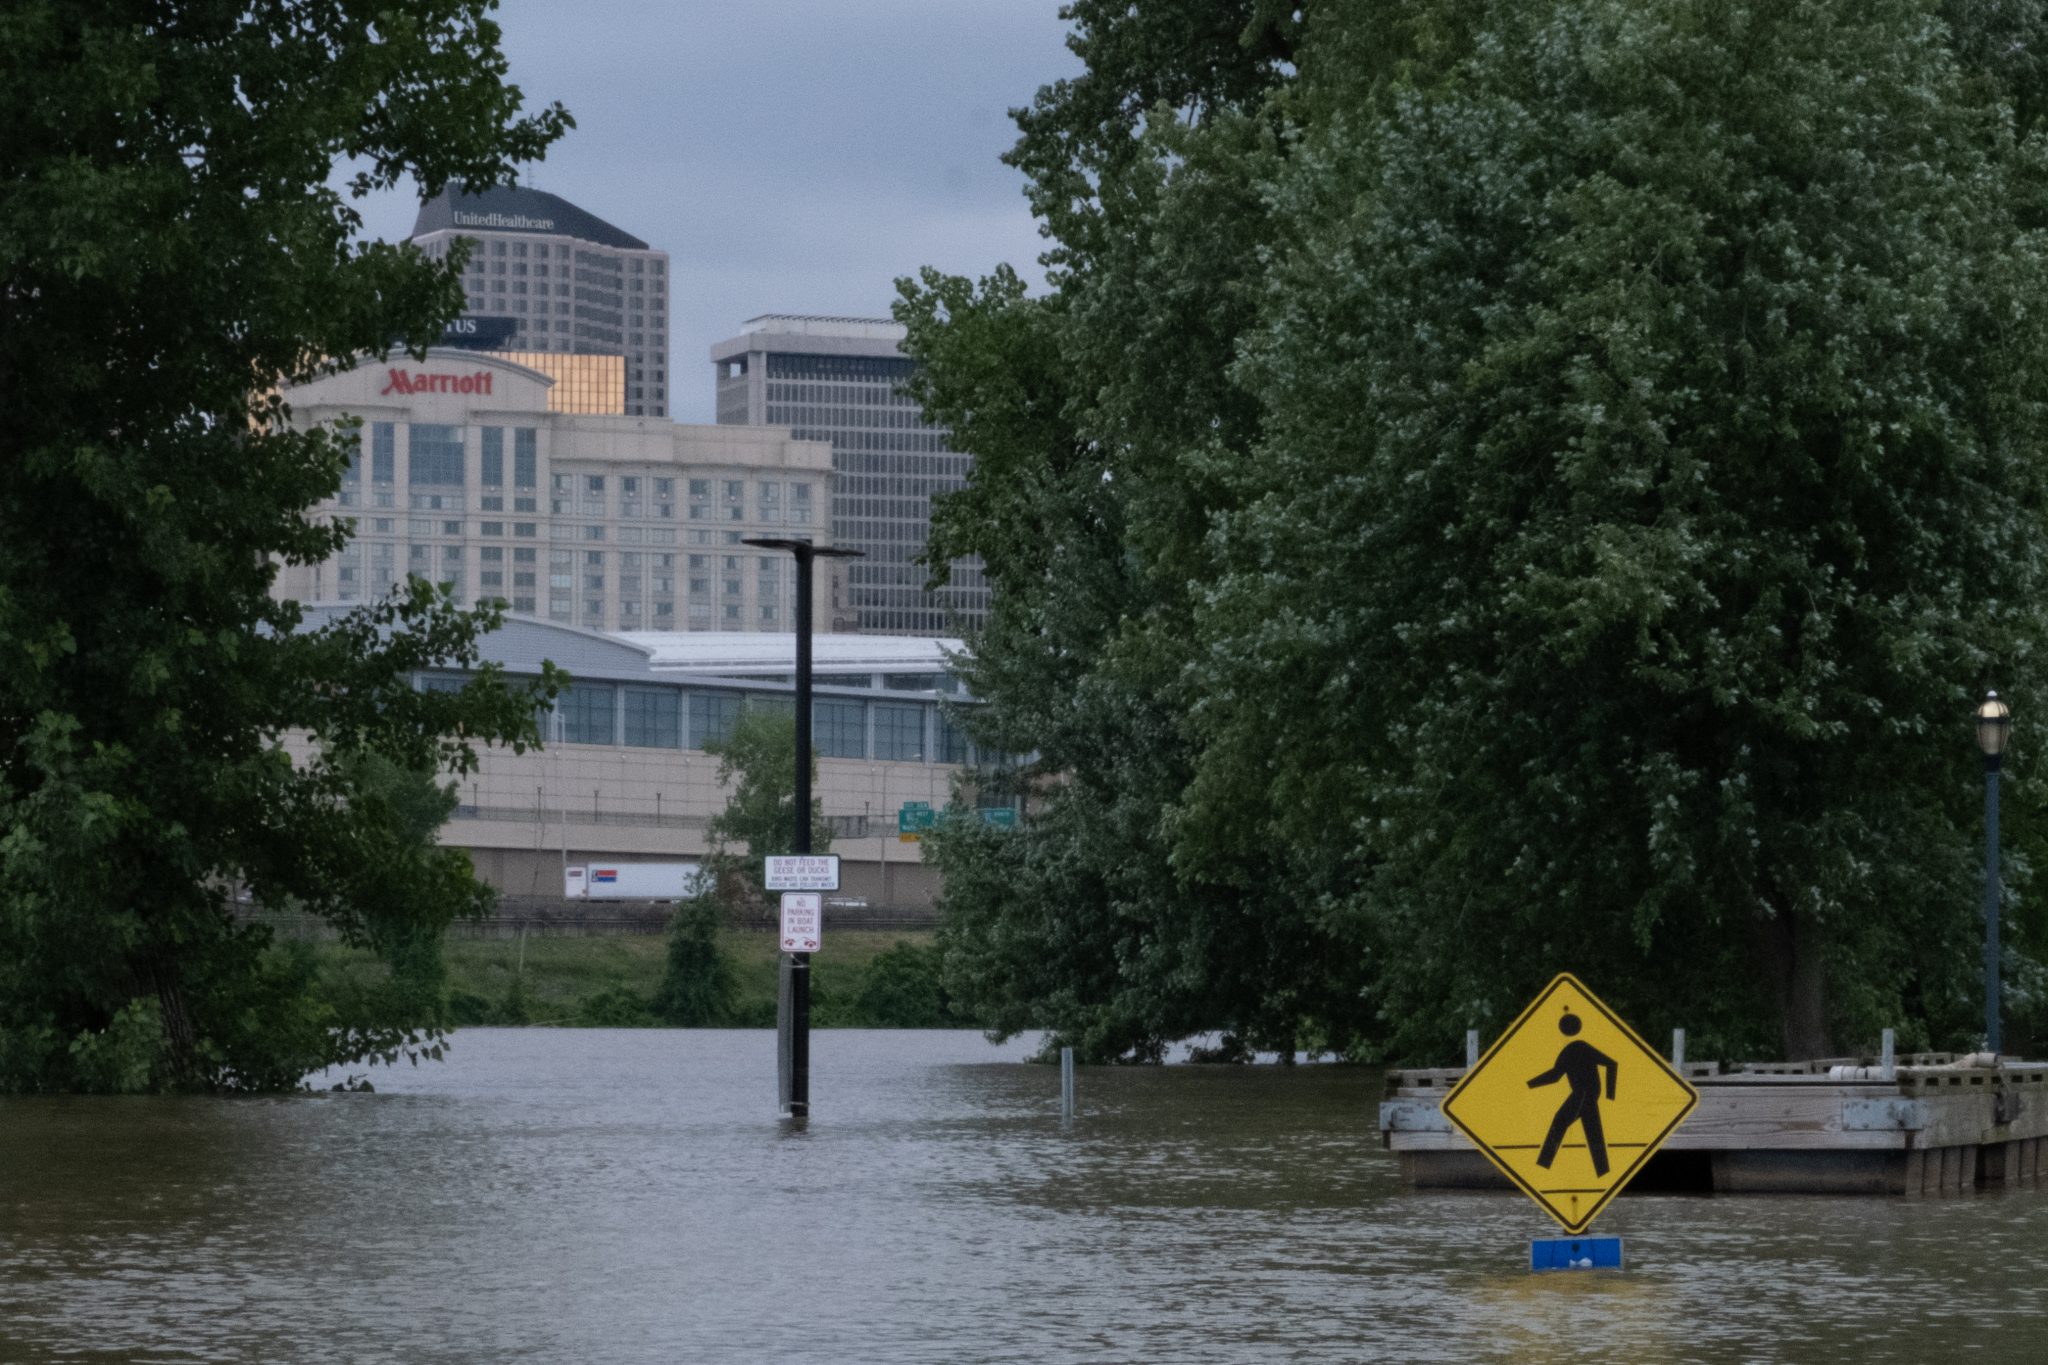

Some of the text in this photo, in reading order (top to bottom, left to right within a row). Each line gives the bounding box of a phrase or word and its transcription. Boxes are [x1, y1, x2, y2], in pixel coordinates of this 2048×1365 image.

[454, 211, 554, 229] UnitedHealthcare
[381, 368, 493, 395] Marriott
[773, 866, 829, 874] GEESE OR DUCKS
[787, 908, 815, 916] PARKING
[787, 926, 814, 934] LAUNCH
